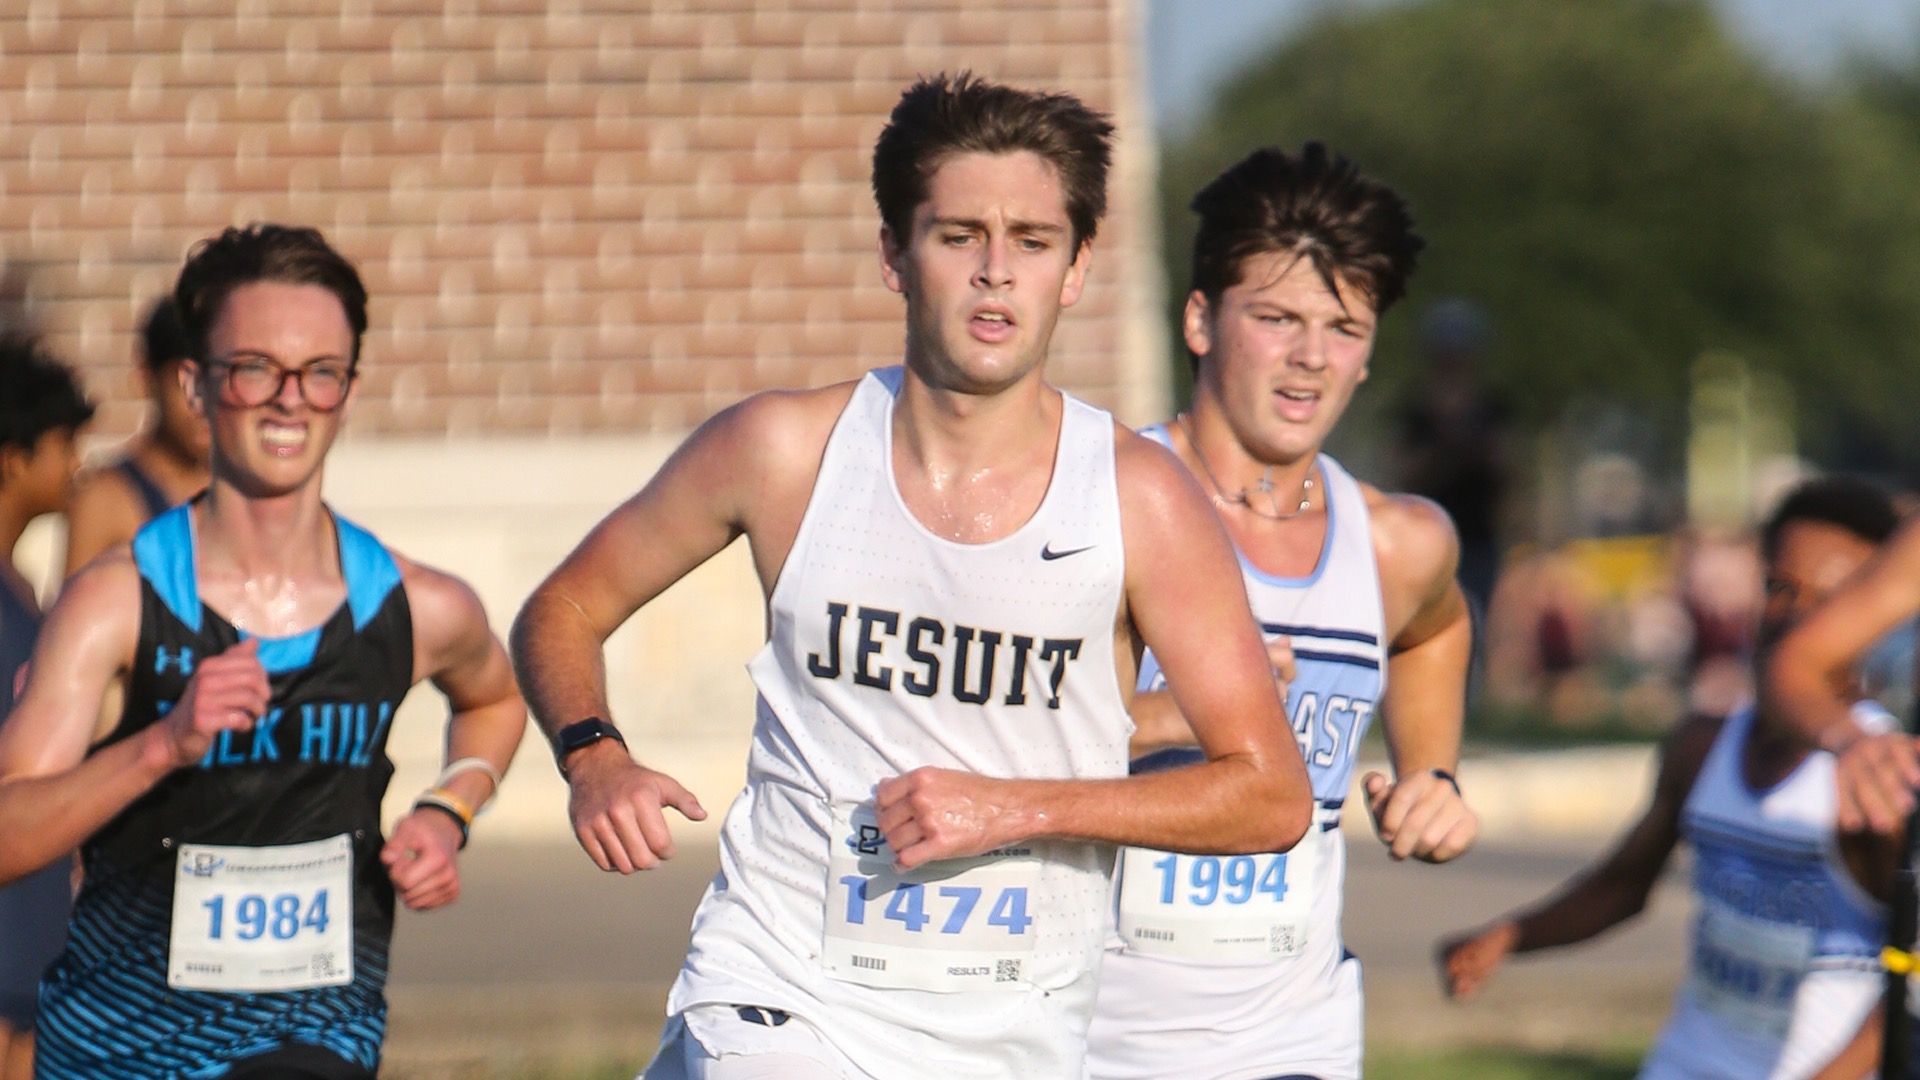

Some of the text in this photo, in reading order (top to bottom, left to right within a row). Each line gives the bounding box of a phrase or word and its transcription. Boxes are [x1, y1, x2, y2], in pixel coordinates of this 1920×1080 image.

[806, 601, 1084, 710] JESUIT
[1291, 691, 1373, 769] AST
[839, 874, 1033, 935] 1474
[1153, 854, 1289, 907] 1994
[203, 887, 330, 942] 1984
[946, 965, 991, 977] RESULTS
